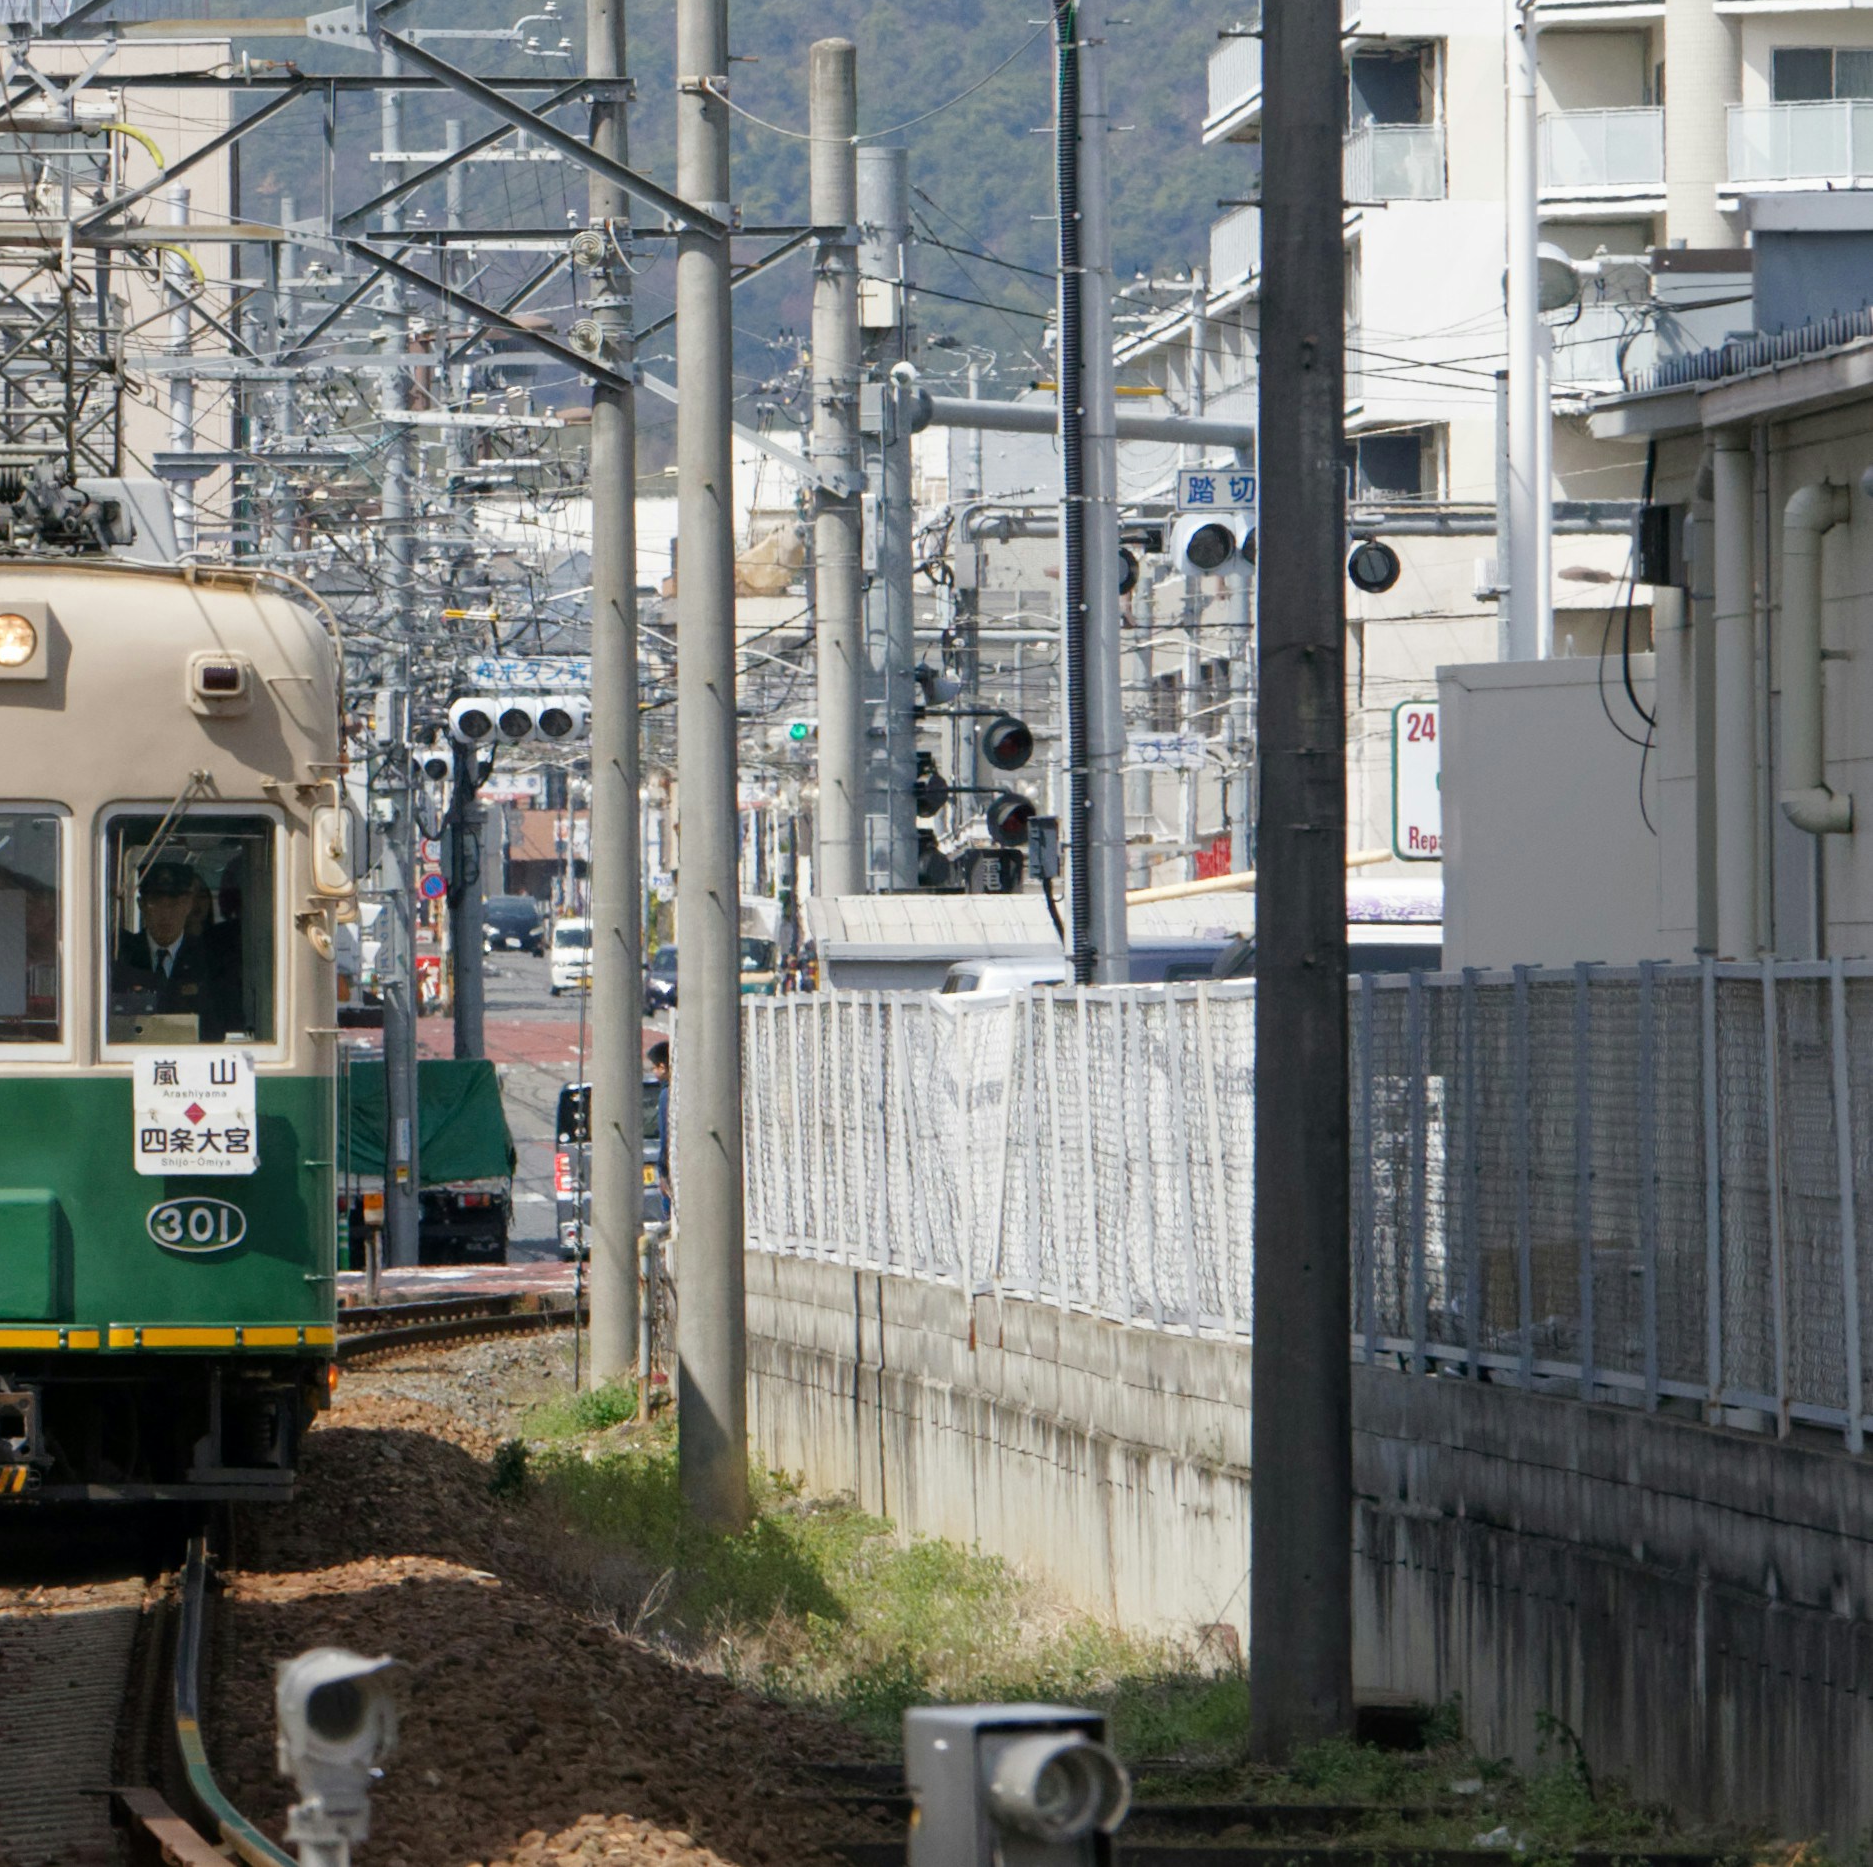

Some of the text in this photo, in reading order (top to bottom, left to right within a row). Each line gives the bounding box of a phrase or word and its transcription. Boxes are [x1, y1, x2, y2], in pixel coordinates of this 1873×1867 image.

[1407, 713, 1436, 742] 24
[153, 1058, 236, 1085] 嵐山
[162, 1089, 228, 1100] Arashiyama
[141, 1128, 250, 1153] 四条大宮
[157, 1207, 228, 1242] 301
